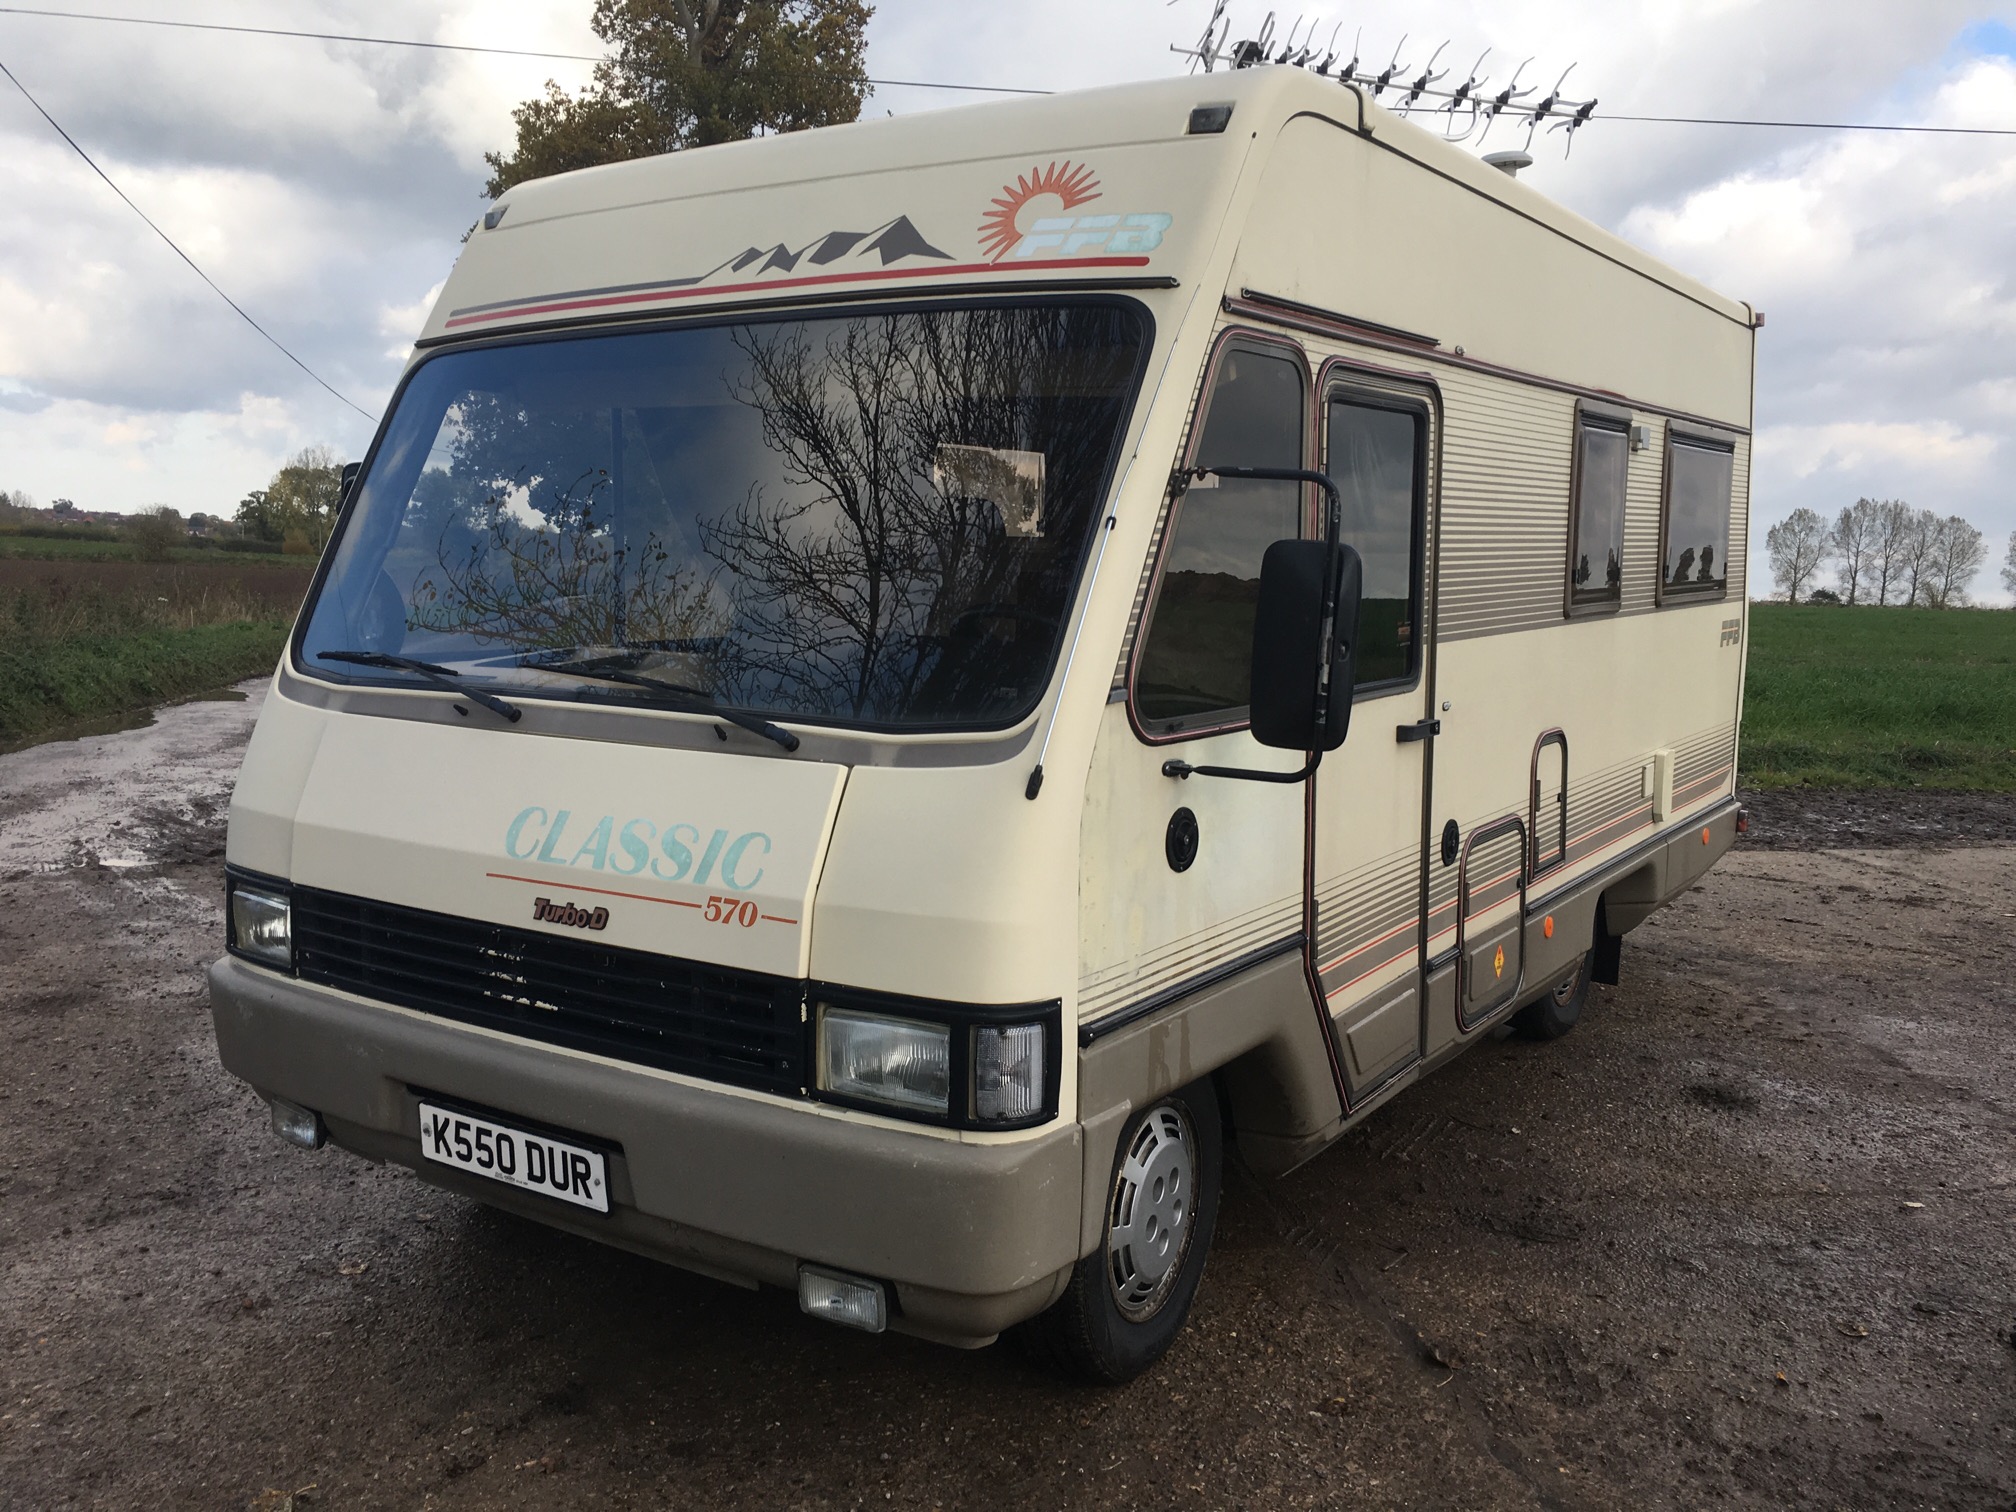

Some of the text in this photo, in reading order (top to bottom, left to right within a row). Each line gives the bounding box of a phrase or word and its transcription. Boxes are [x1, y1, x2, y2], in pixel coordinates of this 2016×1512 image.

[1015, 212, 1173, 257] FFB
[505, 806, 772, 891] CLASSIC
[704, 896, 758, 928] 570
[433, 1114, 593, 1199] K550 DUR
